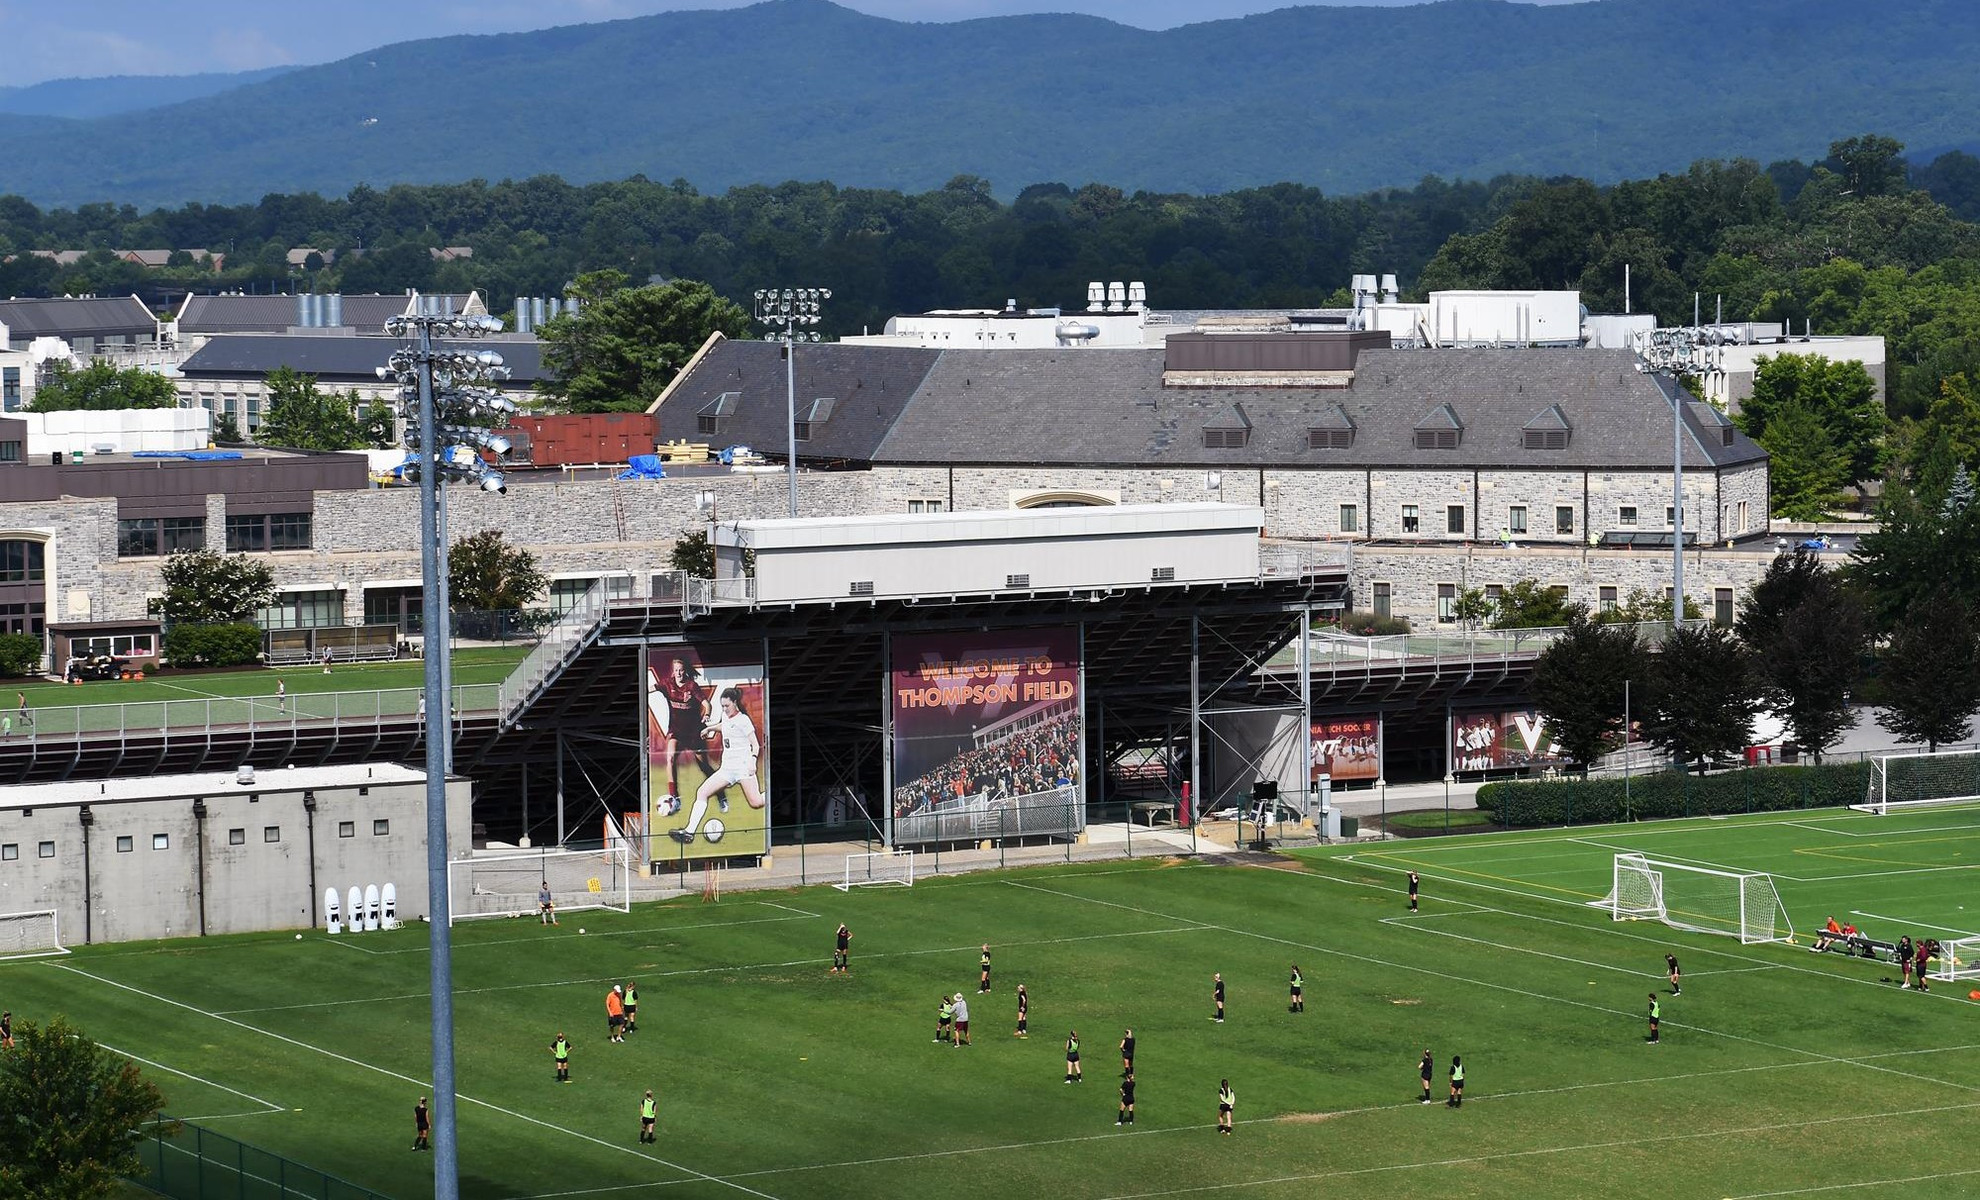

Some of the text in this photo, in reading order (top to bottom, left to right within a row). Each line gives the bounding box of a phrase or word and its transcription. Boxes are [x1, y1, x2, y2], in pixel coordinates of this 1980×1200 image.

[920, 654, 1053, 681] WELCOME TO
[898, 680, 1074, 709] THOMPSON FIELD
